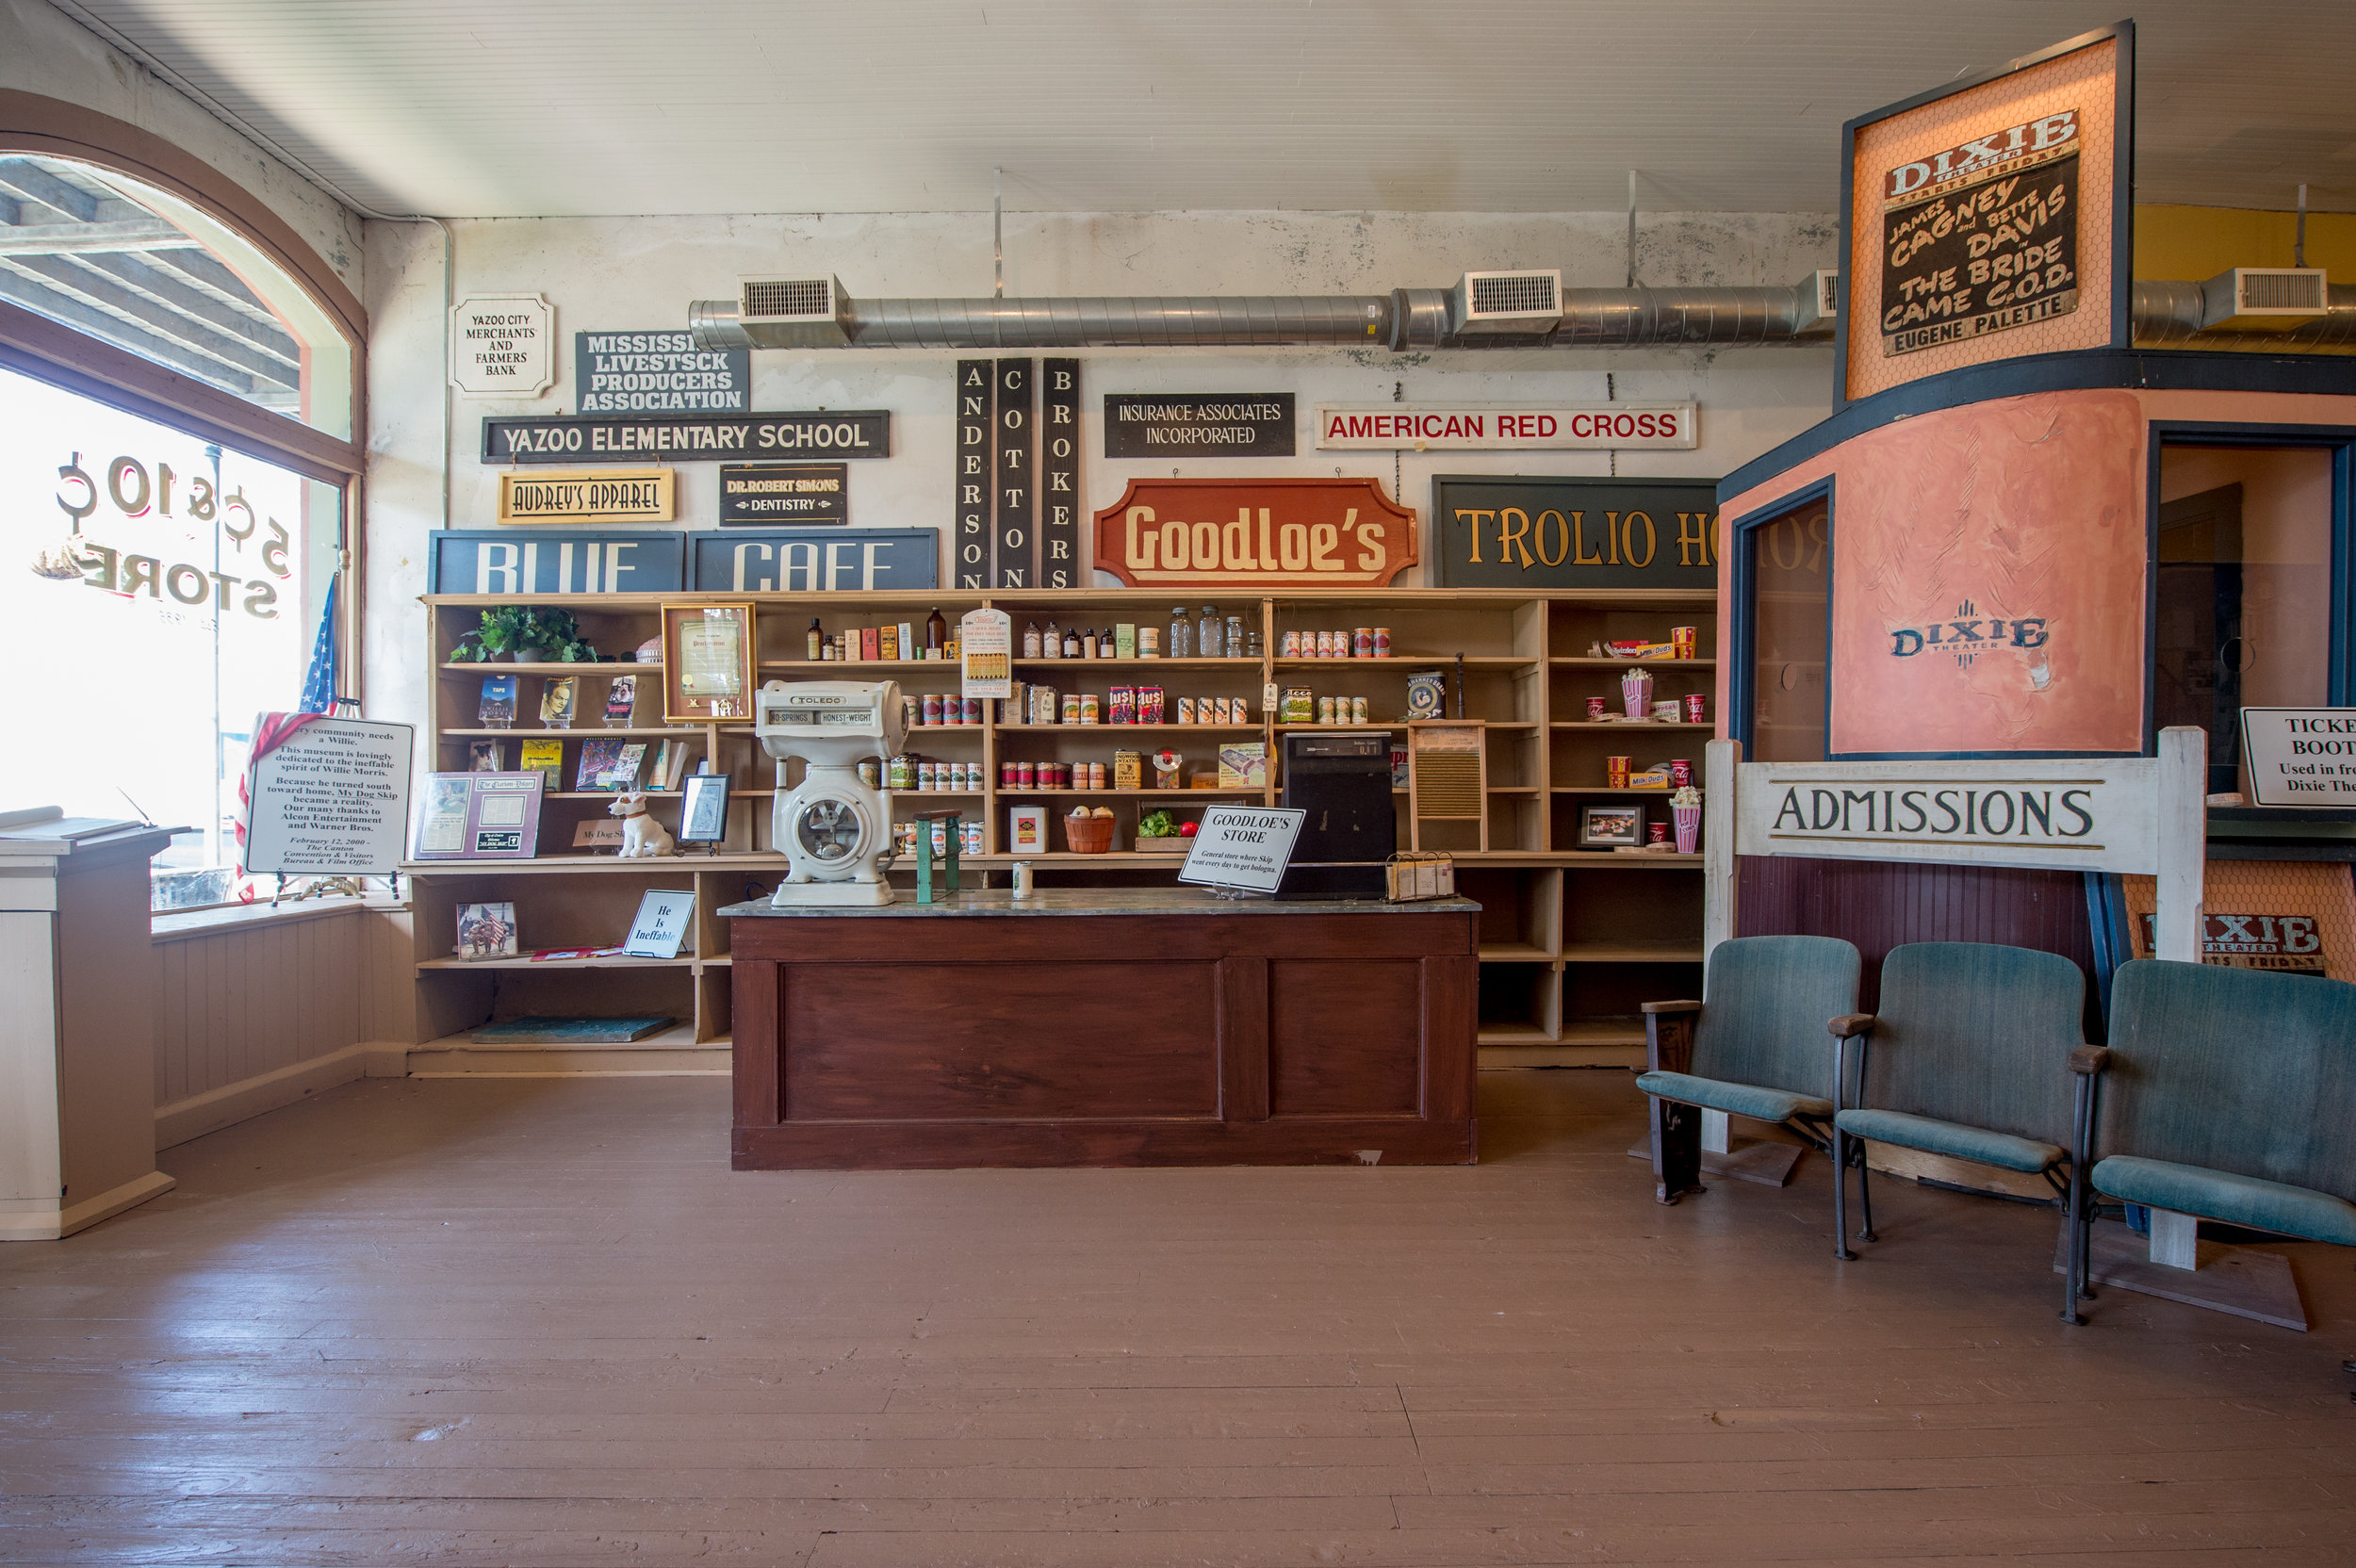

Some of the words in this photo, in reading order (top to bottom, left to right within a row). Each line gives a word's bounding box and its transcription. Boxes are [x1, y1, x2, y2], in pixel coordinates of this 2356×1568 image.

[1890, 112, 2076, 195] DIXIE
[1938, 150, 2021, 182] THEATER
[1899, 179, 1968, 203] STARTS
[1988, 148, 2063, 177] FRIDAY
[1958, 217, 1976, 233] and
[1987, 189, 2039, 227] BETTE
[1890, 199, 1945, 245] JAMES
[1891, 176, 2020, 267] CAGNEY
[1967, 184, 2066, 258] DAVIS
[1899, 267, 1957, 302] THE
[1968, 236, 2063, 285] BRIDE
[1883, 288, 1972, 331] CAME
[1987, 264, 2073, 306] C.O.D.
[472, 316, 505, 325] YAZOO
[508, 315, 530, 324] CITY
[1895, 321, 1962, 351] EUGENE
[1976, 295, 2061, 334] PALETTE
[466, 328, 535, 338] MERCHANTS
[489, 341, 513, 351] AND
[476, 353, 527, 363] FARMERS
[486, 366, 516, 375] BANK
[591, 371, 732, 391] PRODUCERS
[581, 390, 742, 411] ASSOCIATION
[1120, 404, 1192, 422] INSURANCE
[1196, 404, 1281, 421] ASSOCIATES
[1329, 415, 1483, 438] AMERICAN
[1497, 415, 1558, 437] RED
[1572, 414, 1677, 438] CROSS
[503, 428, 582, 452] YAZOO
[592, 425, 750, 450] ELEMENTARY
[758, 423, 869, 448] SCHOOL
[1146, 427, 1255, 445] INCORPORATED
[795, 479, 839, 491] SIMONS
[963, 368, 985, 589] ANDERSON
[1004, 369, 1024, 588] COTTON
[1049, 370, 1072, 589] BROKERS
[513, 483, 583, 511] AUDREY'S
[589, 482, 660, 509] APPAREL
[751, 498, 815, 510] DENTISTRY
[1125, 506, 1385, 571] Goodloe's
[1454, 508, 1657, 571] TROLIO
[1675, 511, 1718, 567] H
[1890, 618, 2049, 657] DIXIE
[1655, 645, 1672, 653] Duds
[1933, 643, 1998, 651] THEATER
[771, 713, 808, 722] NO-SPRINGS
[823, 713, 871, 722] HONEST-WEIGHT
[313, 728, 366, 739] community
[329, 737, 357, 745] Willie.
[2292, 741, 2356, 754] BOOT
[275, 755, 322, 763] dedicated
[355, 759, 394, 769] ineffable
[357, 751, 392, 760] lovingly
[281, 764, 306, 773] spirit
[353, 768, 388, 776] Morris.
[2279, 763, 2315, 775] Used
[2320, 764, 2333, 775] in
[276, 777, 316, 786] Because
[333, 780, 364, 789] turned
[367, 782, 391, 791] south
[1632, 776, 1645, 785] Milk
[2287, 779, 2326, 792] Dixie
[338, 789, 352, 797] My
[356, 790, 374, 799] Dog
[378, 792, 398, 800] Skip
[341, 798, 373, 807] reality.
[1773, 786, 2093, 838] ADMISSIONS
[313, 814, 382, 824] Entertainment
[1213, 814, 1290, 829] GOODLOE'S
[290, 837, 330, 845] February
[583, 831, 594, 840] My
[1221, 830, 1267, 843] STORE
[1259, 856, 1272, 864] Skip
[1252, 865, 1276, 874] bologna.
[658, 906, 671, 915] He
[656, 919, 664, 927] Is
[635, 930, 675, 941] Ineffable
[2203, 944, 2276, 953] THEATER
